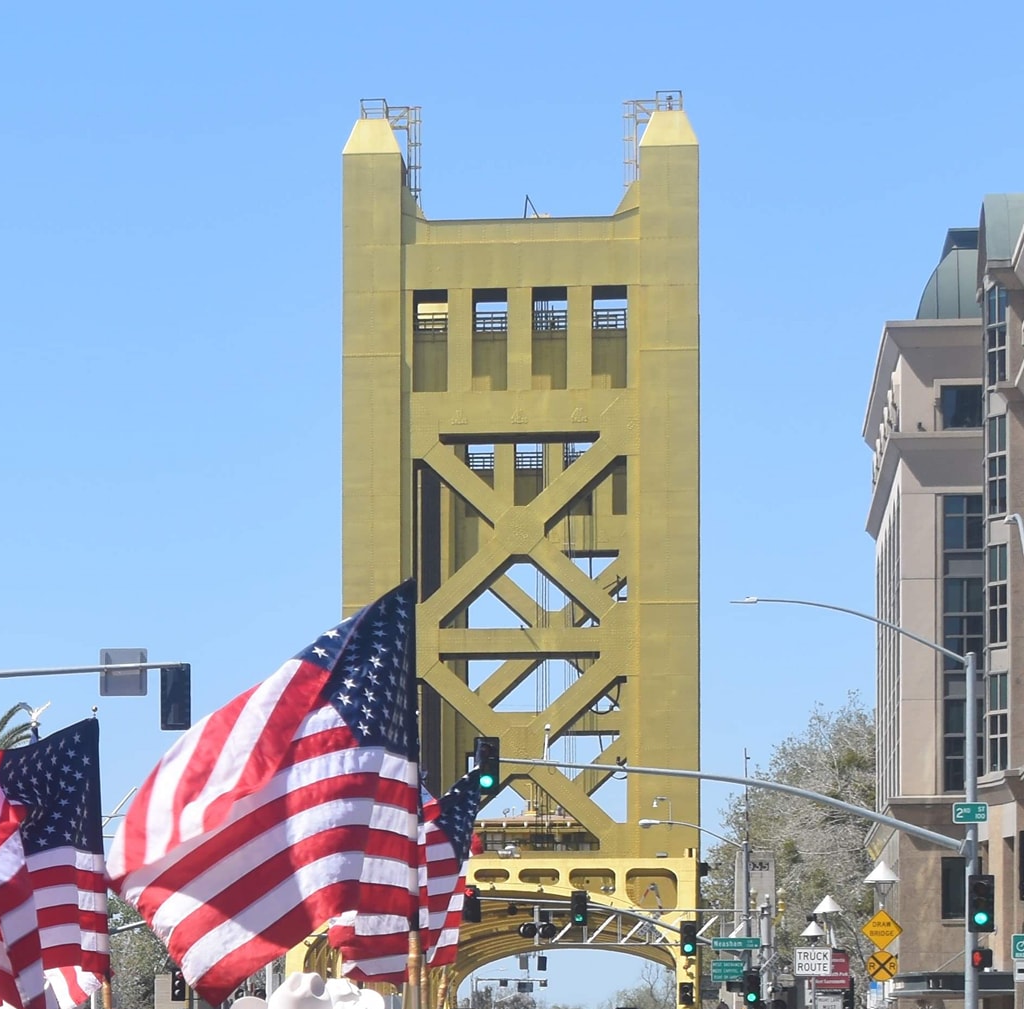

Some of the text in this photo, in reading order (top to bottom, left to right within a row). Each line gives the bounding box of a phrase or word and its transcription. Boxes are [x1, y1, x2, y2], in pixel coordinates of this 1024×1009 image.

[797, 951, 829, 961] TRUCK
[797, 962, 829, 972] ROUTE
[868, 961, 896, 971] R R
